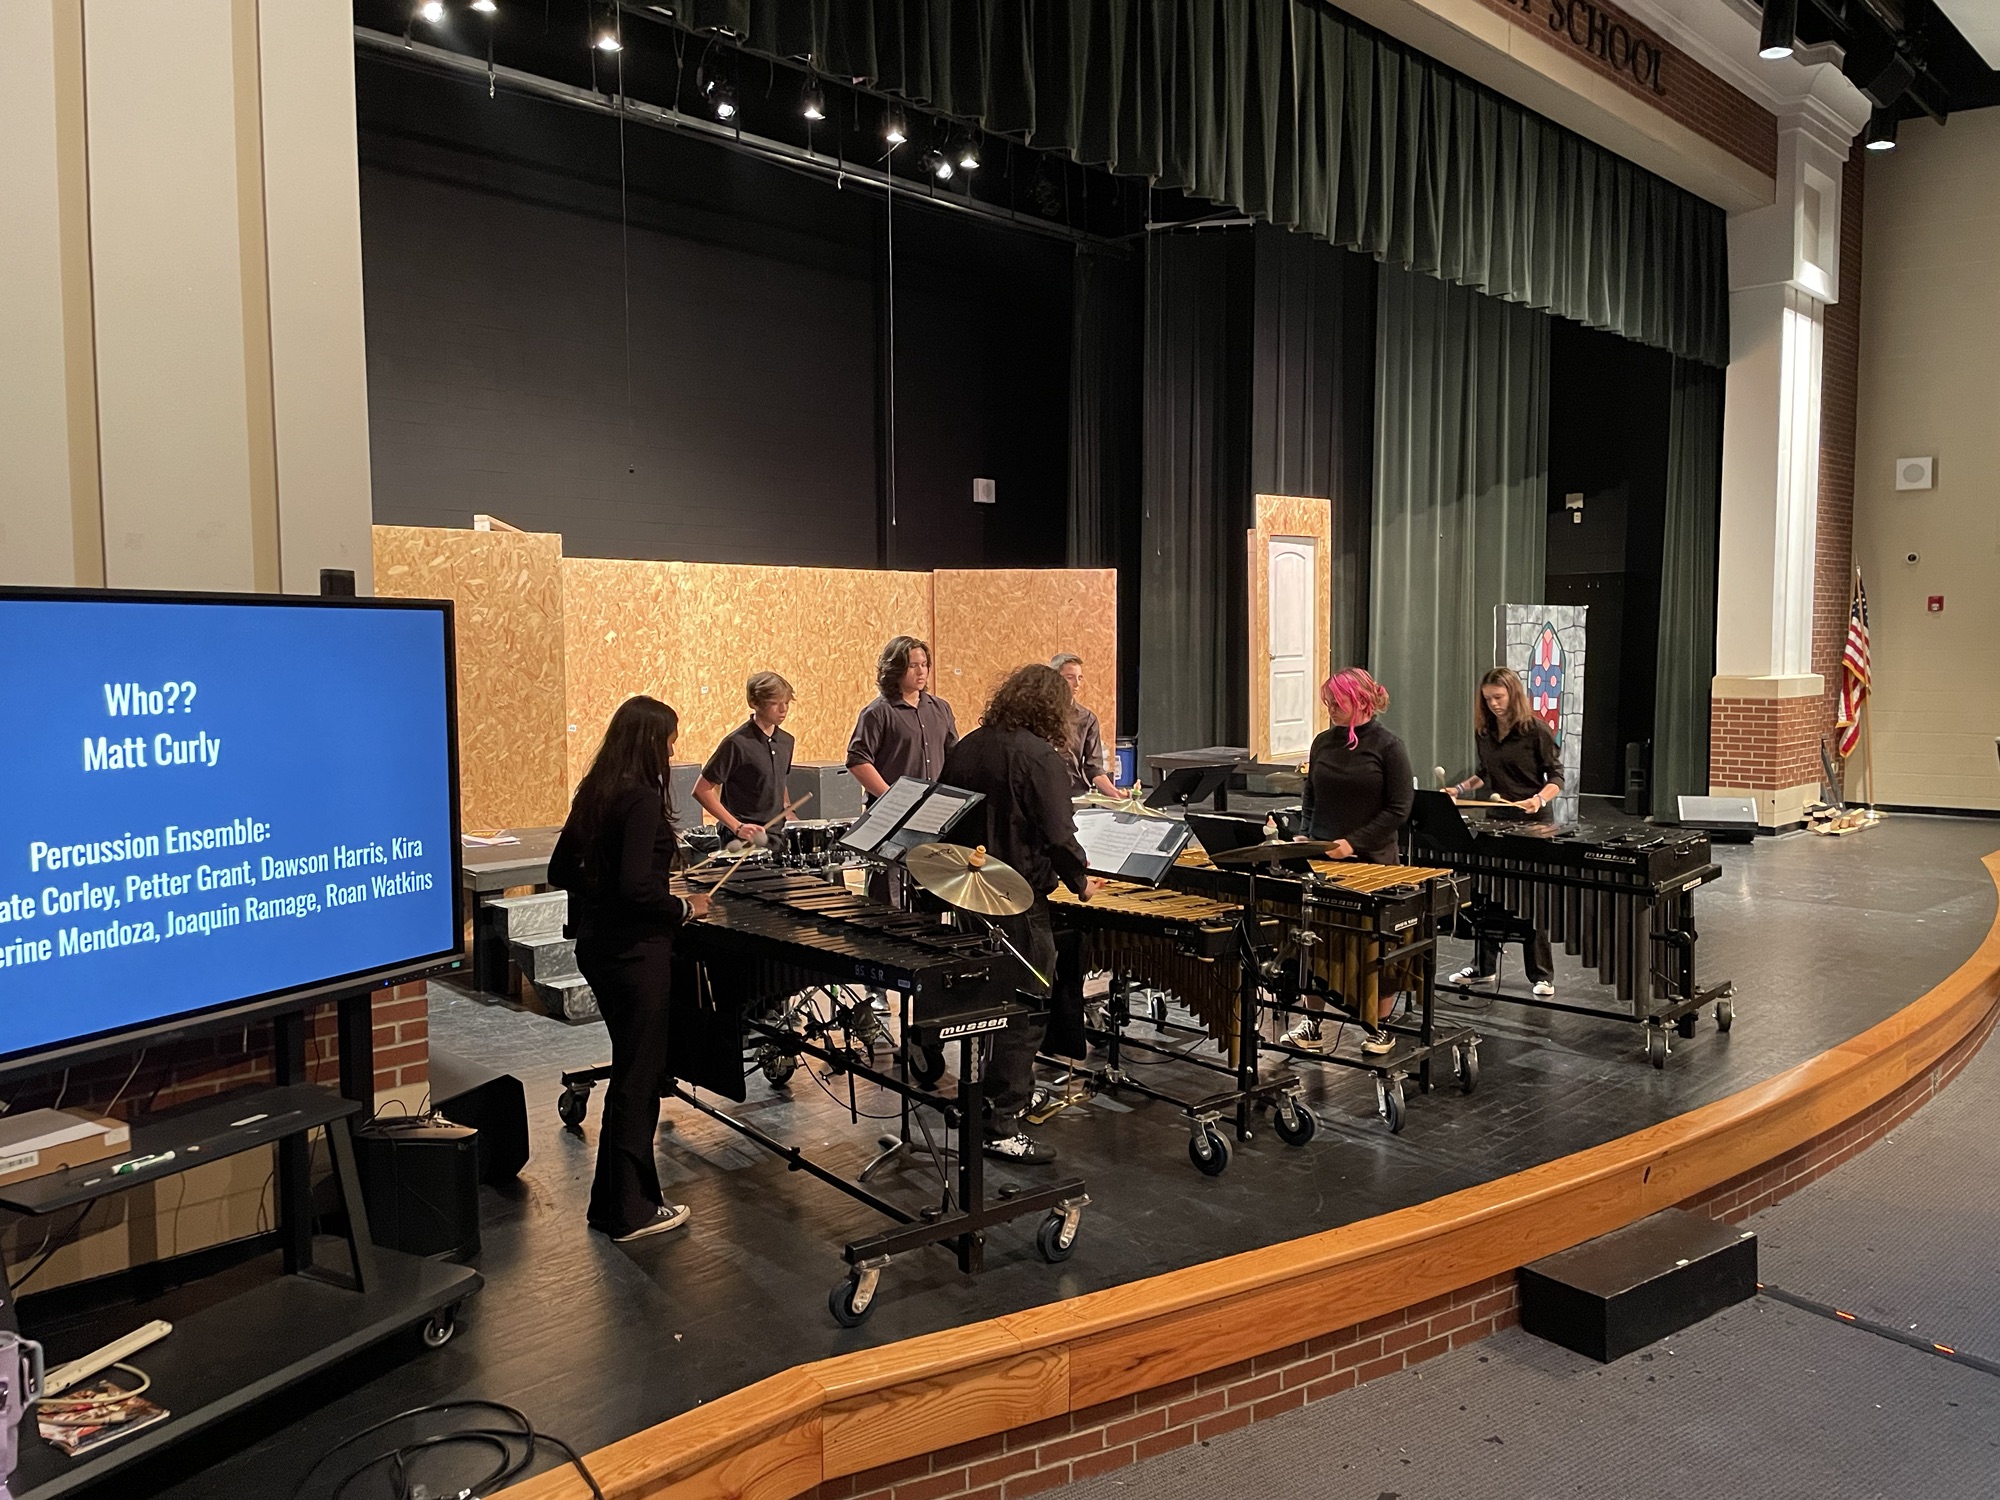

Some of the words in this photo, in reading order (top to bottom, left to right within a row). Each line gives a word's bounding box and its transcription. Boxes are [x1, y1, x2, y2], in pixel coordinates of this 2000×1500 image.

[104, 681, 197, 717] Who??
[83, 736, 148, 772] Matt
[154, 731, 221, 767] Curly
[30, 832, 159, 873] Percussion
[165, 817, 271, 855] Ensemble:
[42, 882, 121, 916] Corley,
[125, 872, 192, 903] Petter
[197, 860, 257, 892] Grant,
[260, 853, 329, 882] Dawson
[333, 845, 388, 871] Harris,
[391, 837, 423, 861] Kira
[58, 920, 161, 957] Mendoza,
[165, 903, 240, 936] Joaquin
[245, 890, 321, 923] Ramage,
[325, 883, 367, 908] Roan
[371, 871, 433, 900] Watkins
